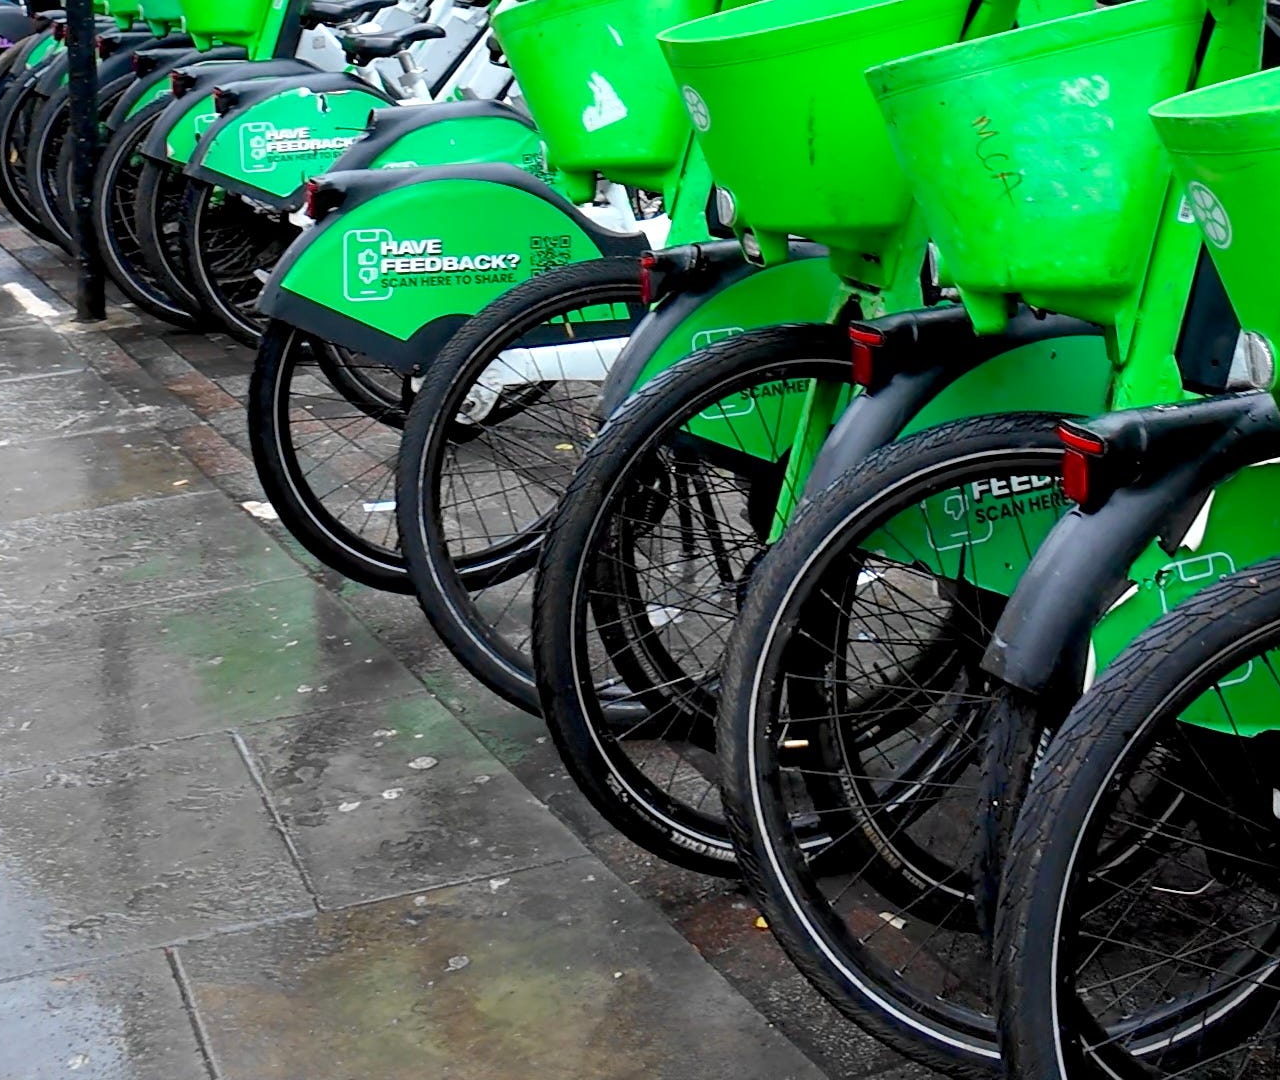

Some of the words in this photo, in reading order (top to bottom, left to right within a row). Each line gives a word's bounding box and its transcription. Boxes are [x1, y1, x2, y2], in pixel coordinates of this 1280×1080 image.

[265, 127, 310, 140] HAVE
[380, 239, 442, 257] HAVE
[380, 254, 520, 275] FEEDBACK?
[381, 277, 418, 289] SCAN
[422, 275, 452, 287] HERE
[456, 275, 471, 286] TO
[475, 272, 517, 284] SHARE.
[975, 501, 1025, 523] SCAN
